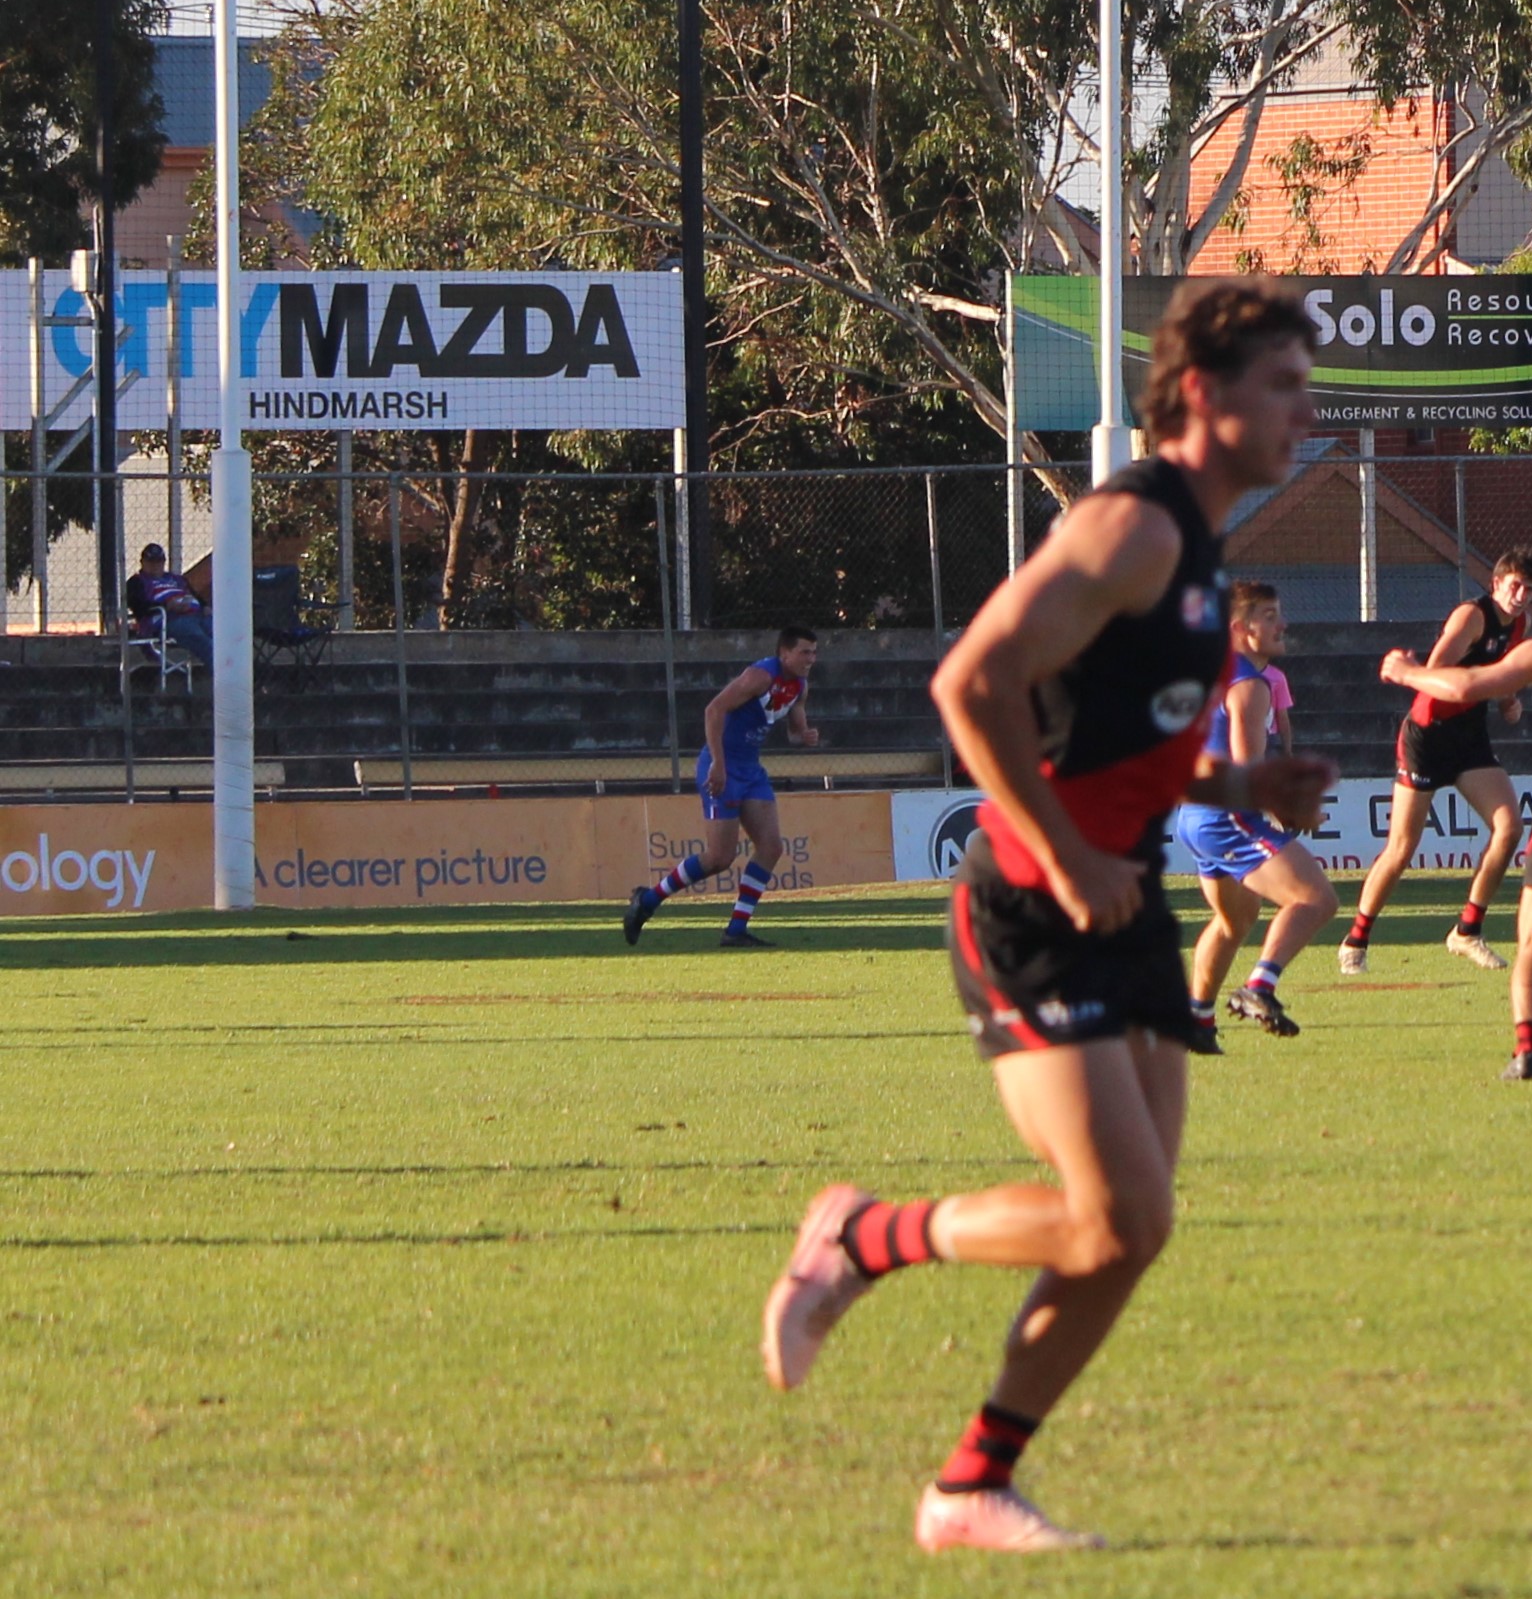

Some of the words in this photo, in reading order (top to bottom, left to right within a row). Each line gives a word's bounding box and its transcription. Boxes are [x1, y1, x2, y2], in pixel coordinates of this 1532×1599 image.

[1303, 288, 1436, 346] Solo
[249, 390, 449, 420] HINDMARSH
[1406, 406, 1416, 419] &
[1422, 405, 1497, 420] RECYCLING
[1, 832, 156, 908] ology
[274, 848, 405, 888] clearer
[415, 848, 547, 897] picture
